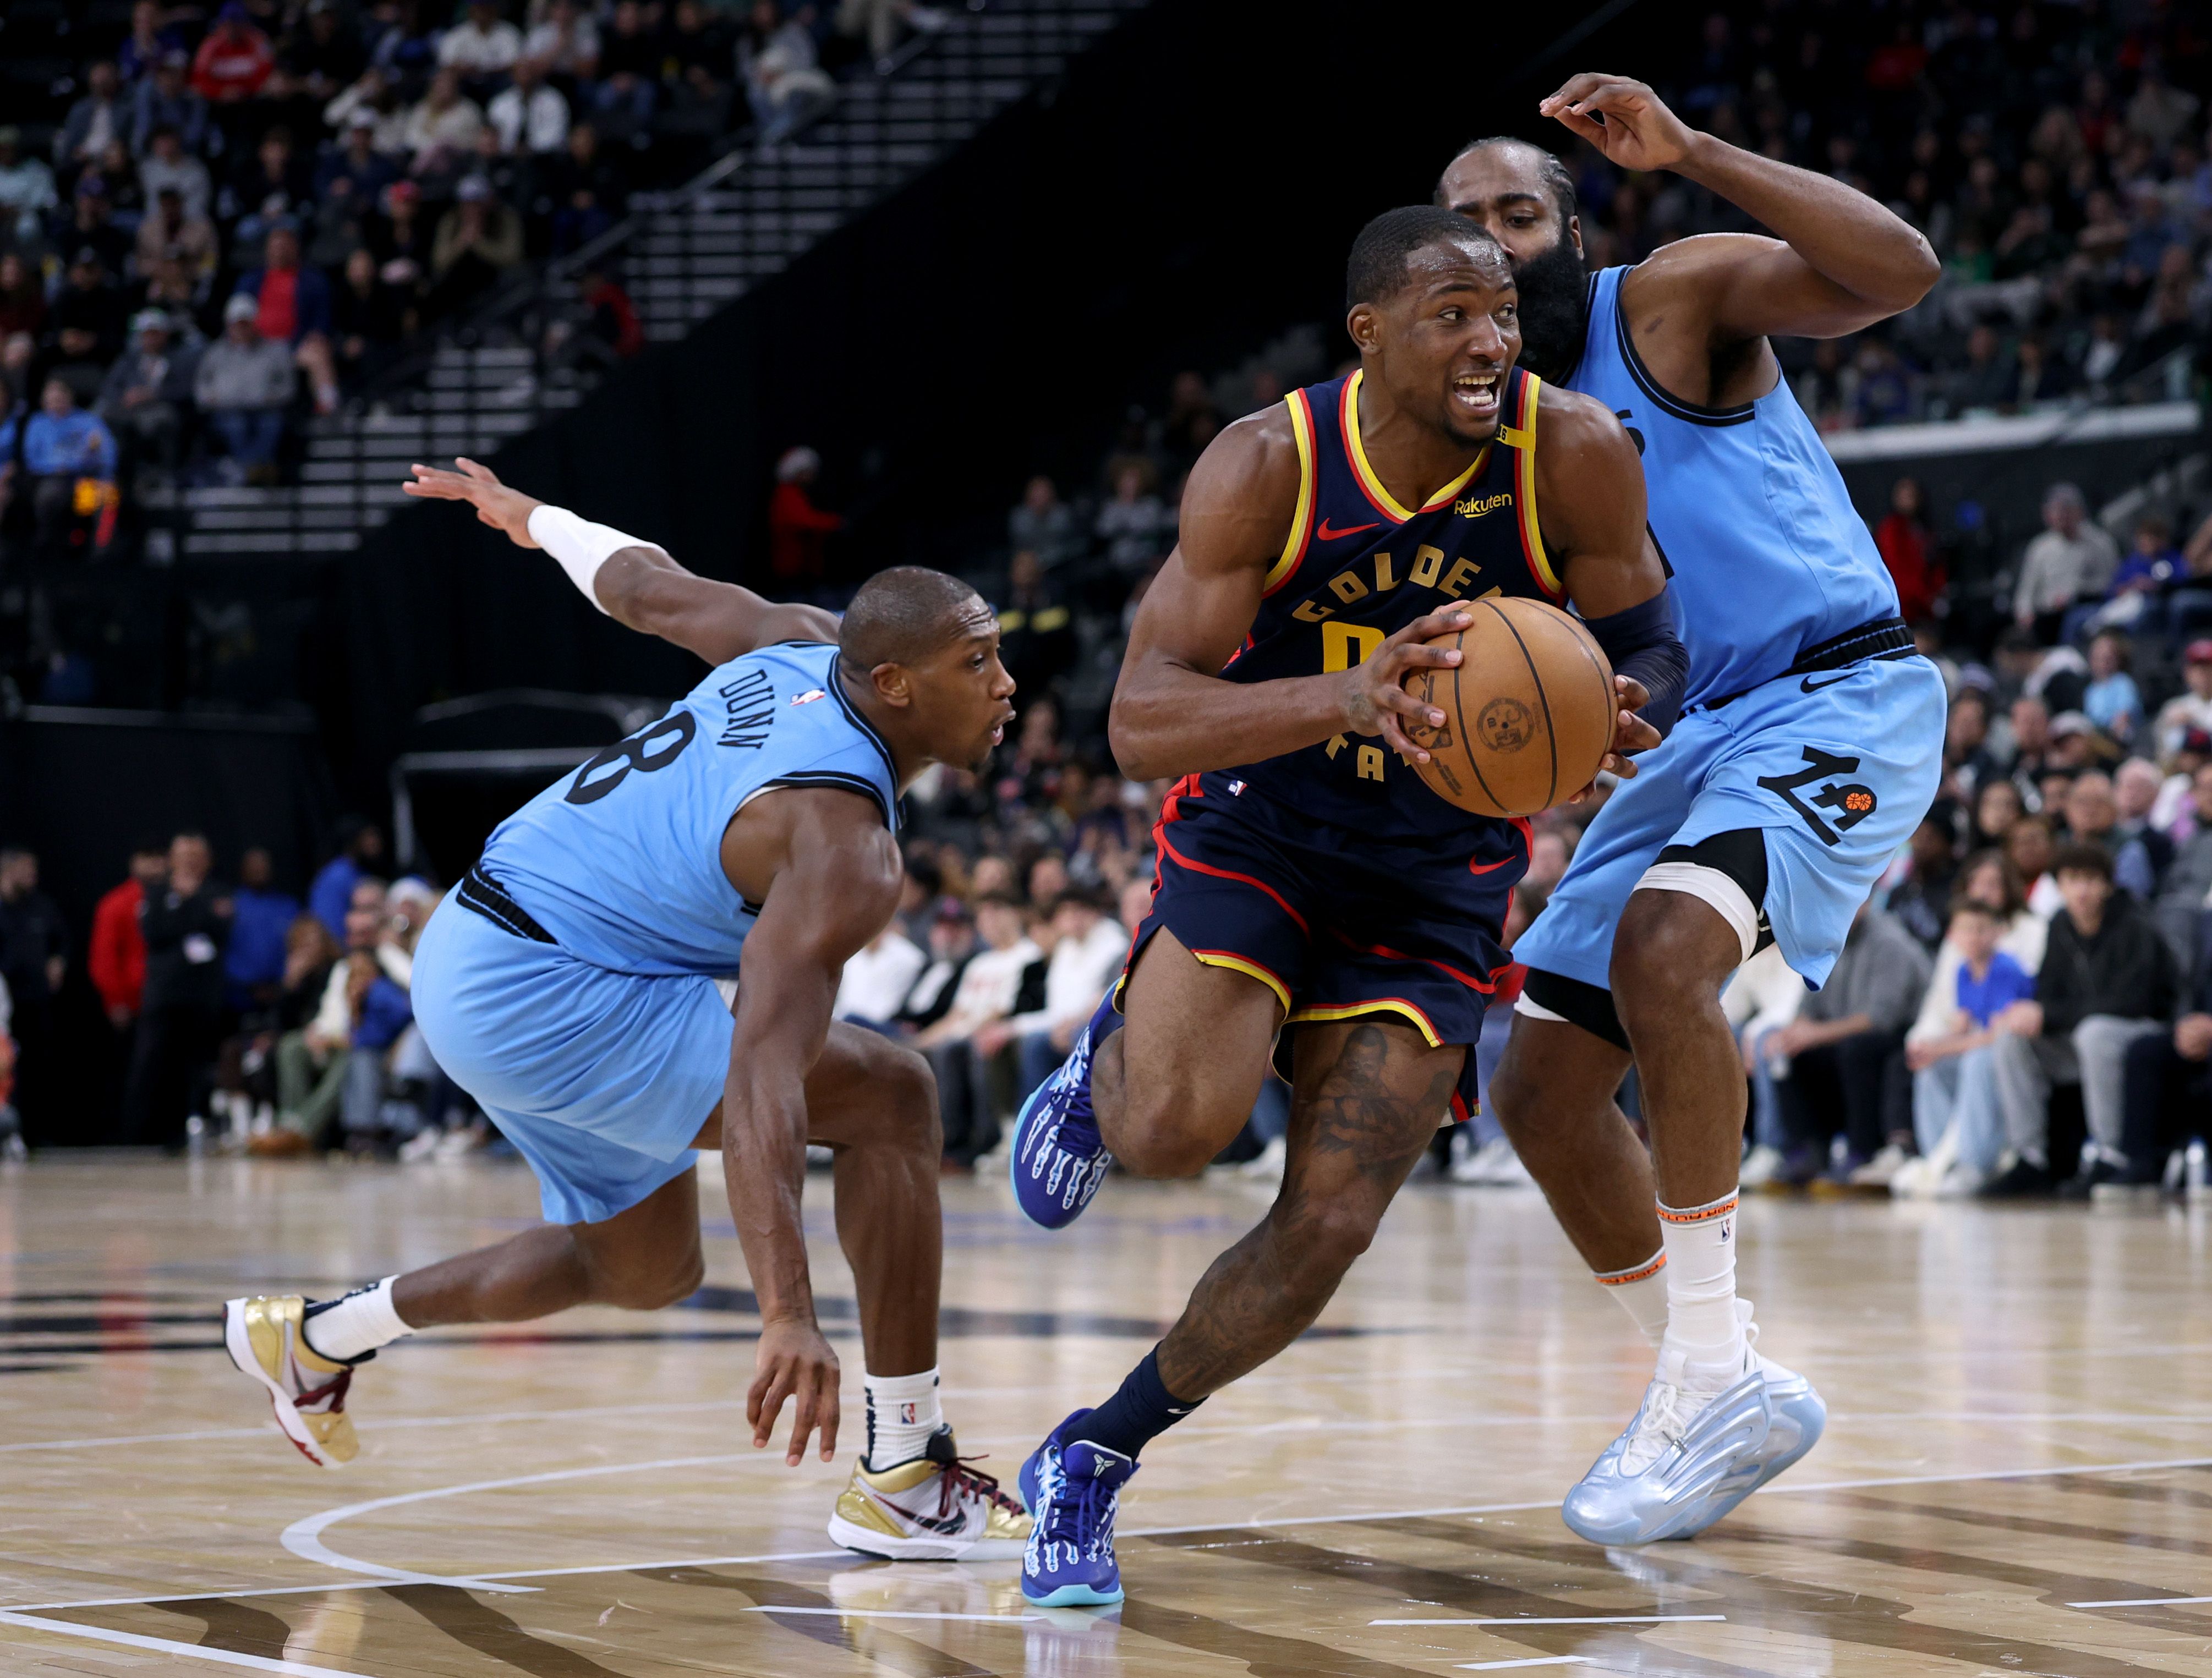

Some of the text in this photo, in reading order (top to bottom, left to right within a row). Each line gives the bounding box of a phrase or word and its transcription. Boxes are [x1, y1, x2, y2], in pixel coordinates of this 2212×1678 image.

[1454, 493, 1512, 518] Rakuten
[1291, 544, 1503, 622] GOLDE
[716, 668, 776, 749] DUNN
[564, 710, 697, 804] 8
